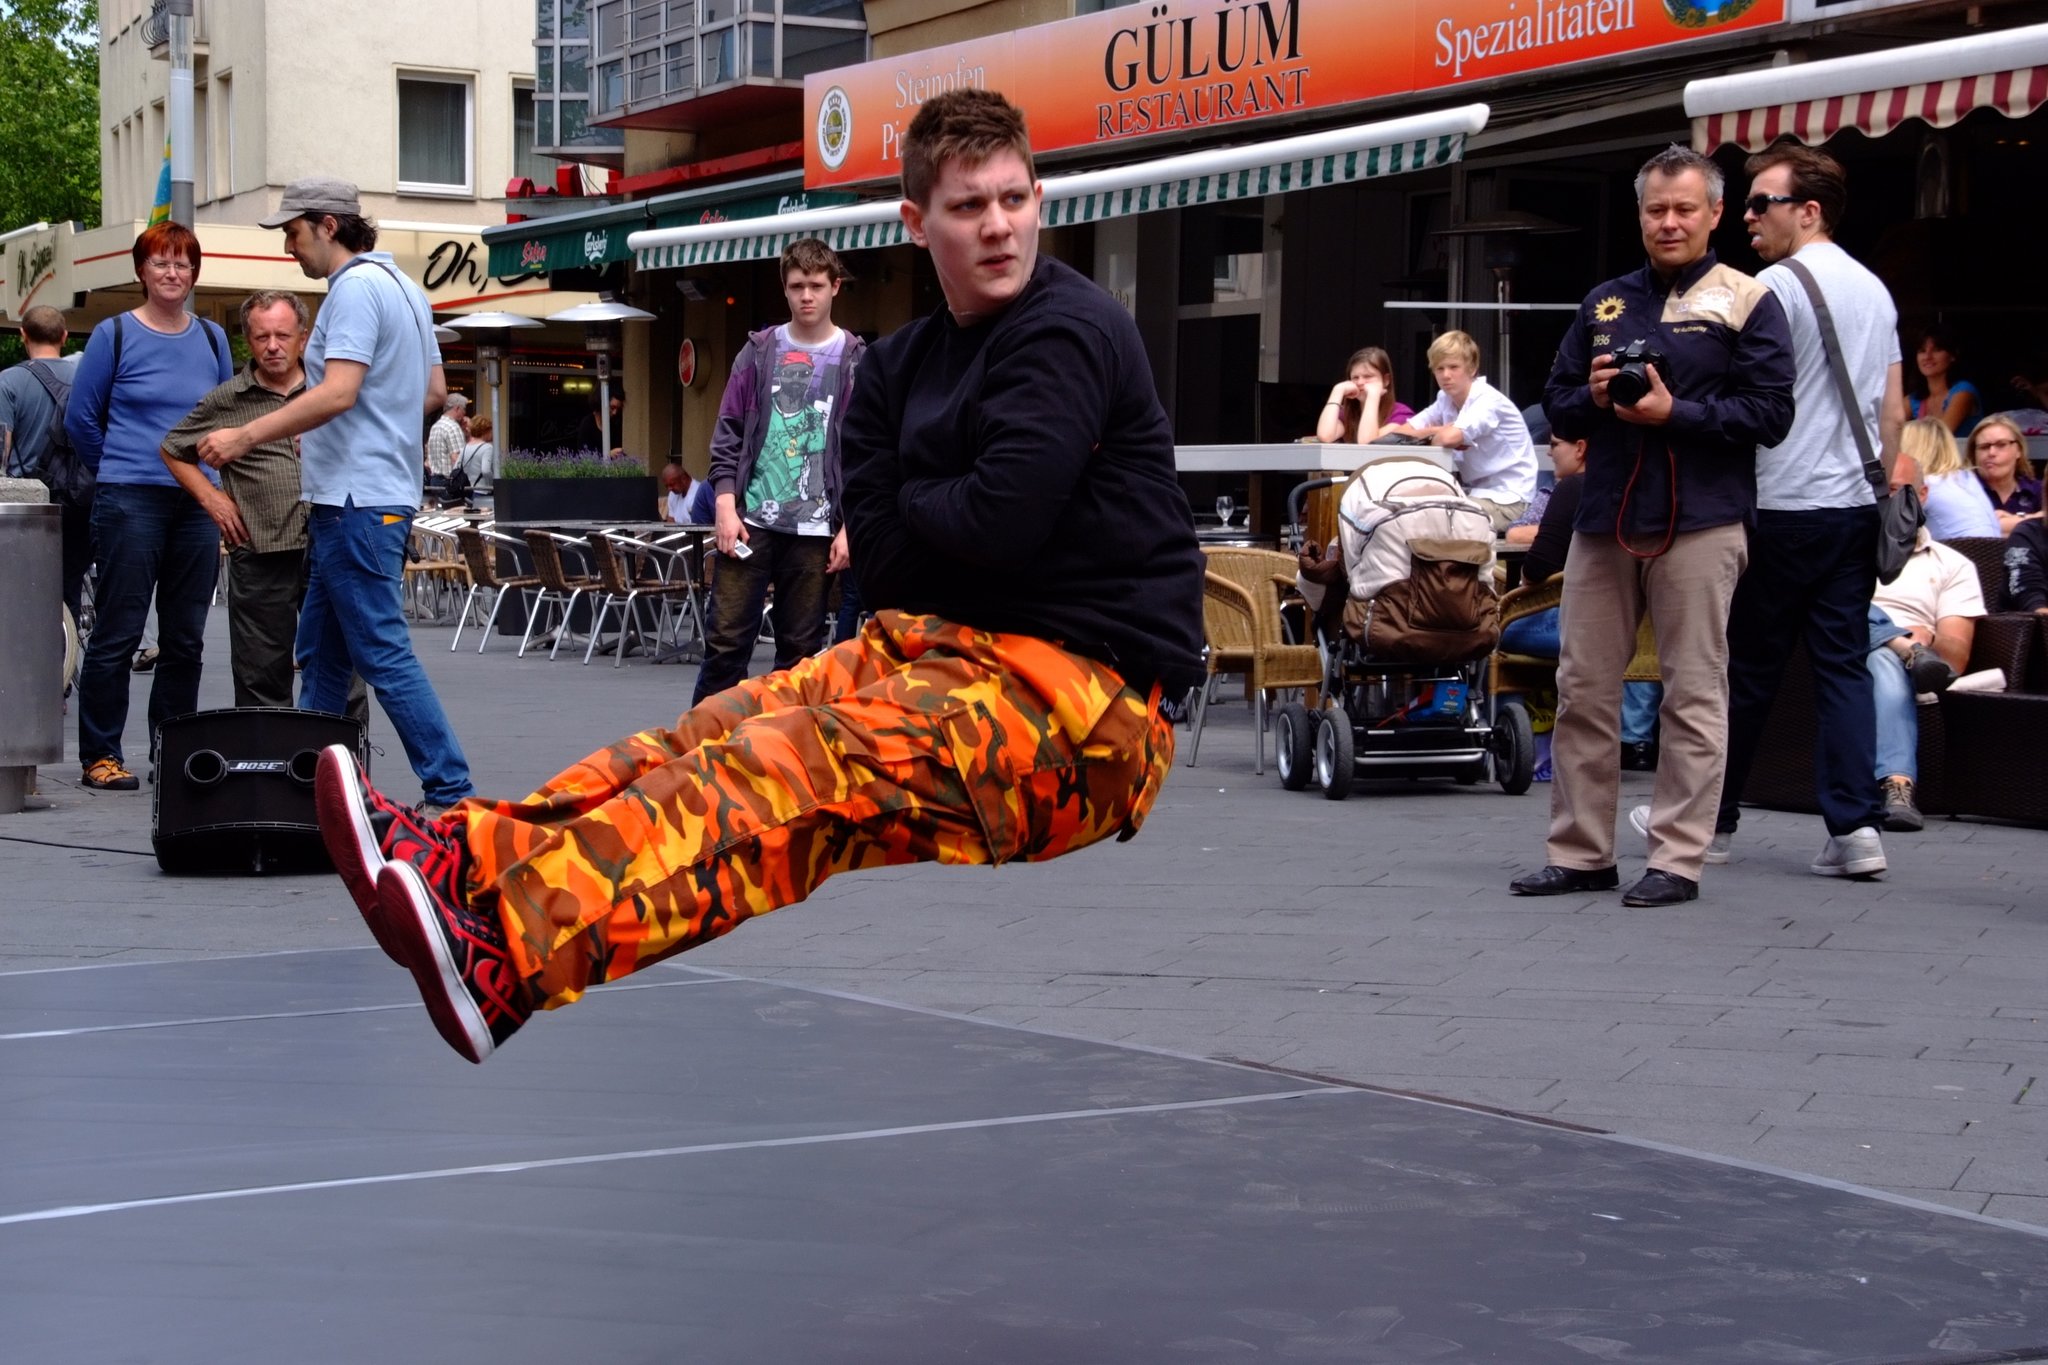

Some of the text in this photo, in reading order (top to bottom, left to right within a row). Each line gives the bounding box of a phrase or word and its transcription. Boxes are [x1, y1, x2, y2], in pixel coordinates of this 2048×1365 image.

[1104, 0, 1303, 92] GÜLÜM
[1097, 68, 1309, 139] RESTAURANT
[423, 240, 488, 294] Oh,
[1593, 334, 1611, 347] 1936
[230, 762, 283, 770] BOSE
